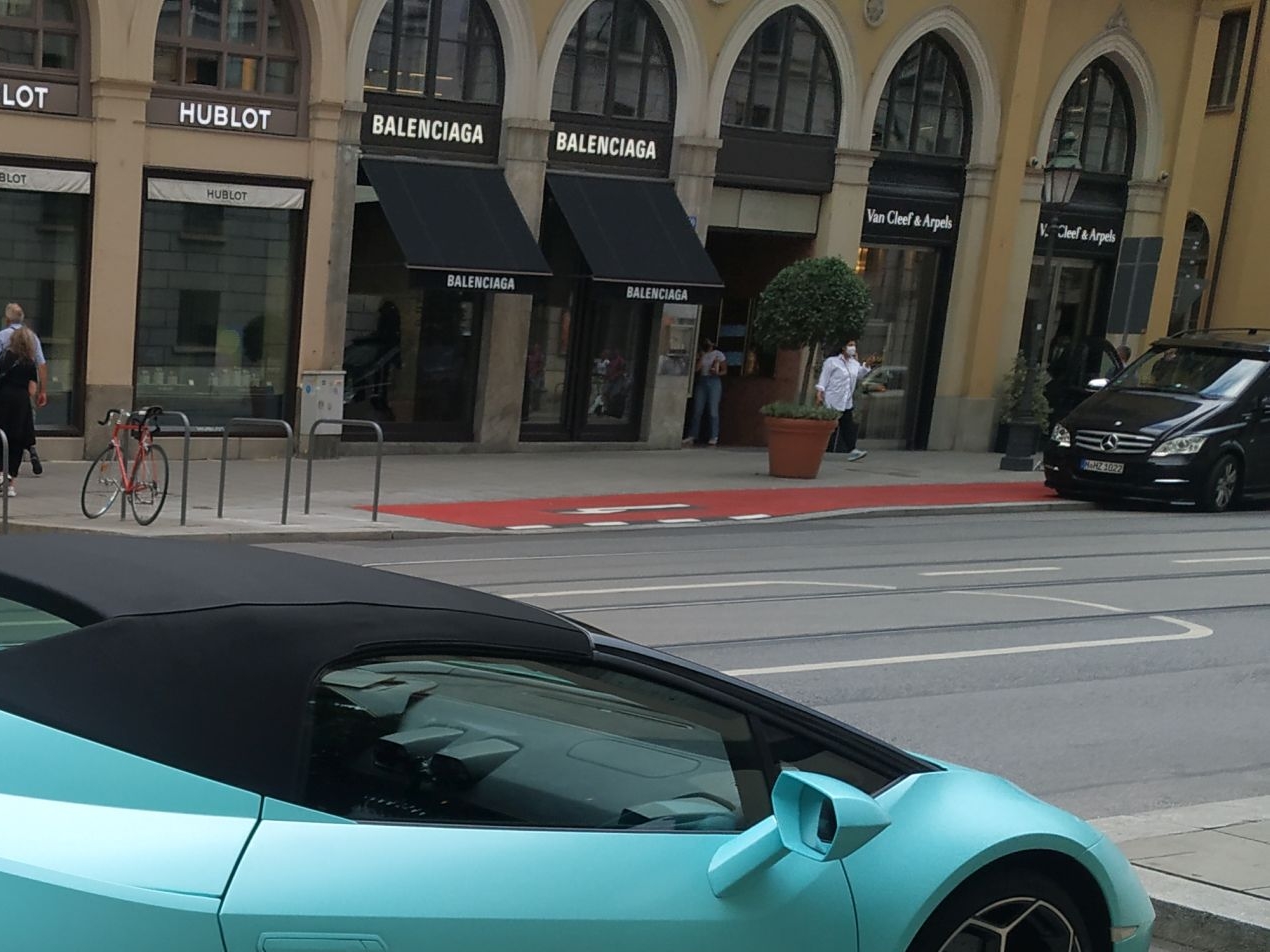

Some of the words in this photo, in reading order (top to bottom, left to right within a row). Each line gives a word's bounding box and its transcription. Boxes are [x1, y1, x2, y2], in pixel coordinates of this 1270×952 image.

[179, 102, 271, 130] HUBLOT
[372, 114, 484, 144] BALENCIAGA
[556, 131, 657, 159] BALENCIAGA
[207, 189, 248, 201] HUBLOT
[867, 208, 885, 224] Van
[887, 210, 914, 226] Cleef
[914, 215, 922, 227] &
[922, 213, 953, 232] Arpels
[1081, 229, 1089, 240] &
[1089, 228, 1116, 246] Arpels
[447, 274, 515, 290] BALENCIAGA
[626, 286, 688, 301] BALENCIAGA
